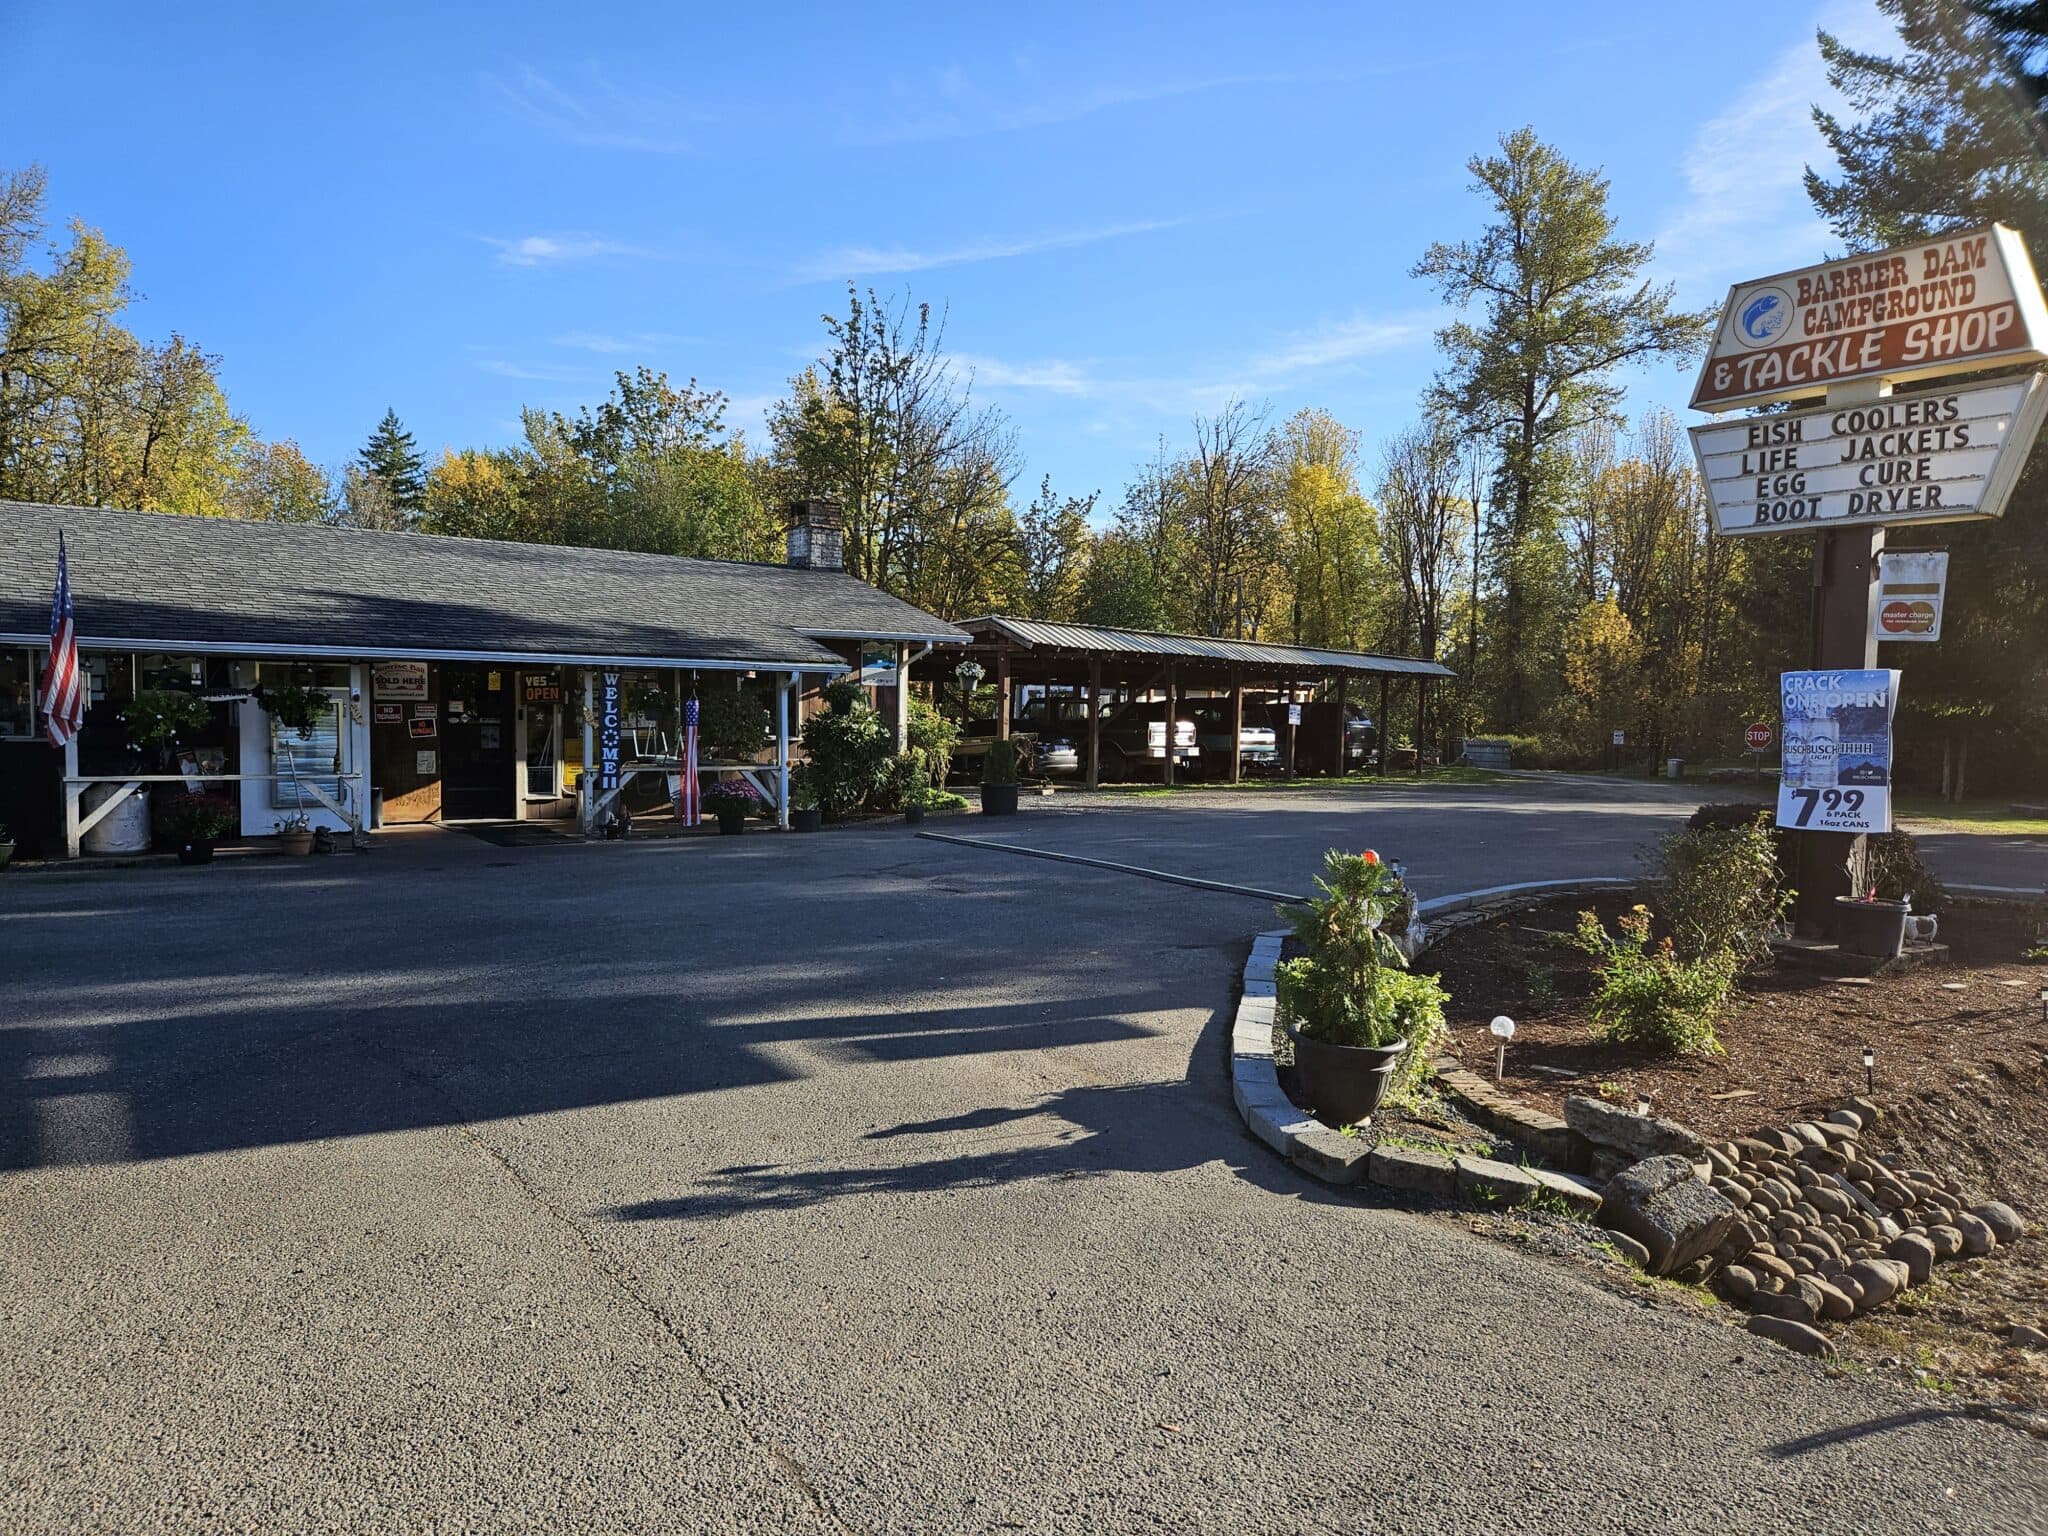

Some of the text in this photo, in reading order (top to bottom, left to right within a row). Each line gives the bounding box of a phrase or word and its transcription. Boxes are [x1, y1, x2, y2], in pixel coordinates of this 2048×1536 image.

[1797, 237, 1986, 307] BARRIER DAM
[1804, 274, 1976, 336] CAMPGROUND
[1713, 304, 2014, 391] & TACKLE SHOP
[1749, 396, 1959, 449] FISH COOLERS
[1742, 424, 1969, 475] LIFE JACKETS
[1756, 458, 1931, 498] EGG CURE
[1756, 485, 1942, 523] BOOT DRYER
[375, 676, 426, 685] SOLD HERE
[526, 676, 547, 687] YES
[1785, 675, 1842, 693] CRACK
[526, 687, 560, 700] OPEN
[1785, 692, 1888, 712] ONE OPEN
[1747, 731, 1770, 740] STOP
[1820, 819, 1870, 829] 16oz CANS
[1834, 811, 1861, 819] PACK
